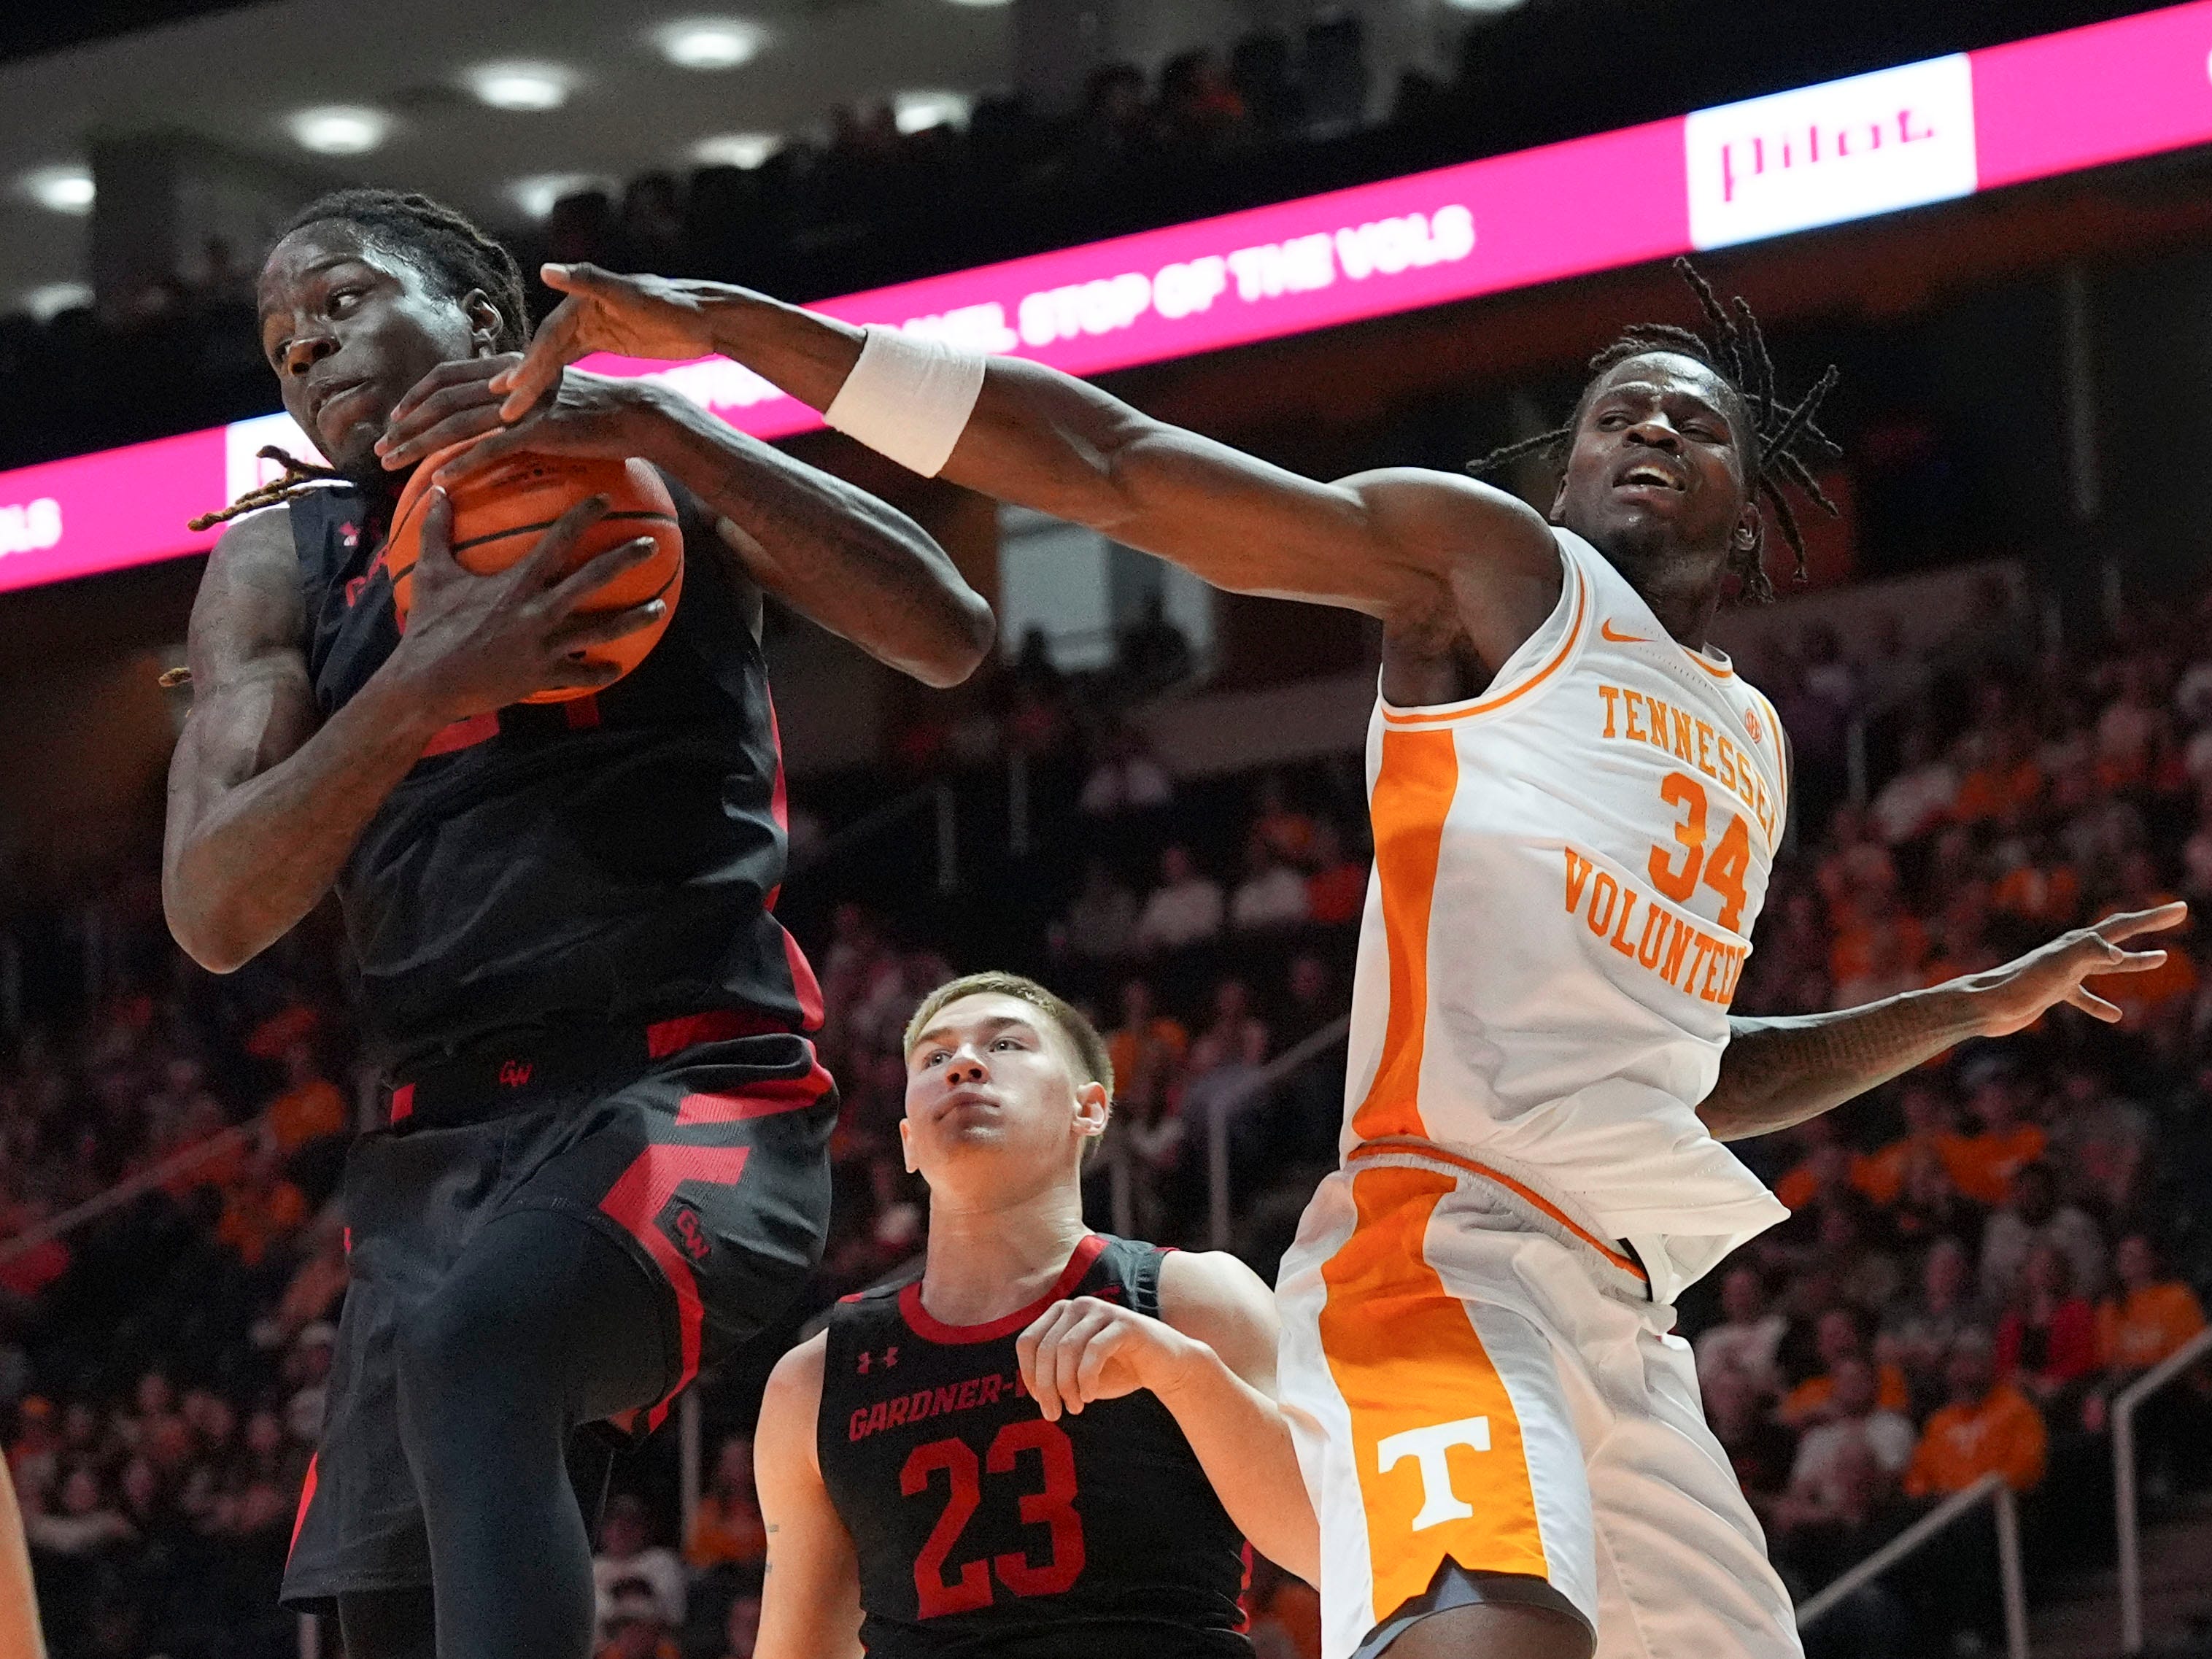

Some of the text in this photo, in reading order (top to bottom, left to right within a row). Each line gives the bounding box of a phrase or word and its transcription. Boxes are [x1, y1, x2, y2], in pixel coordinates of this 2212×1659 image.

[1020, 273, 1151, 347] STOP
[1153, 255, 1226, 319] OF
[1229, 233, 1337, 302] THE
[1336, 204, 1475, 280] VOLS
[1647, 771, 1751, 935] 34
[900, 1418, 1086, 1620] 23
[1377, 1415, 1491, 1531] T
